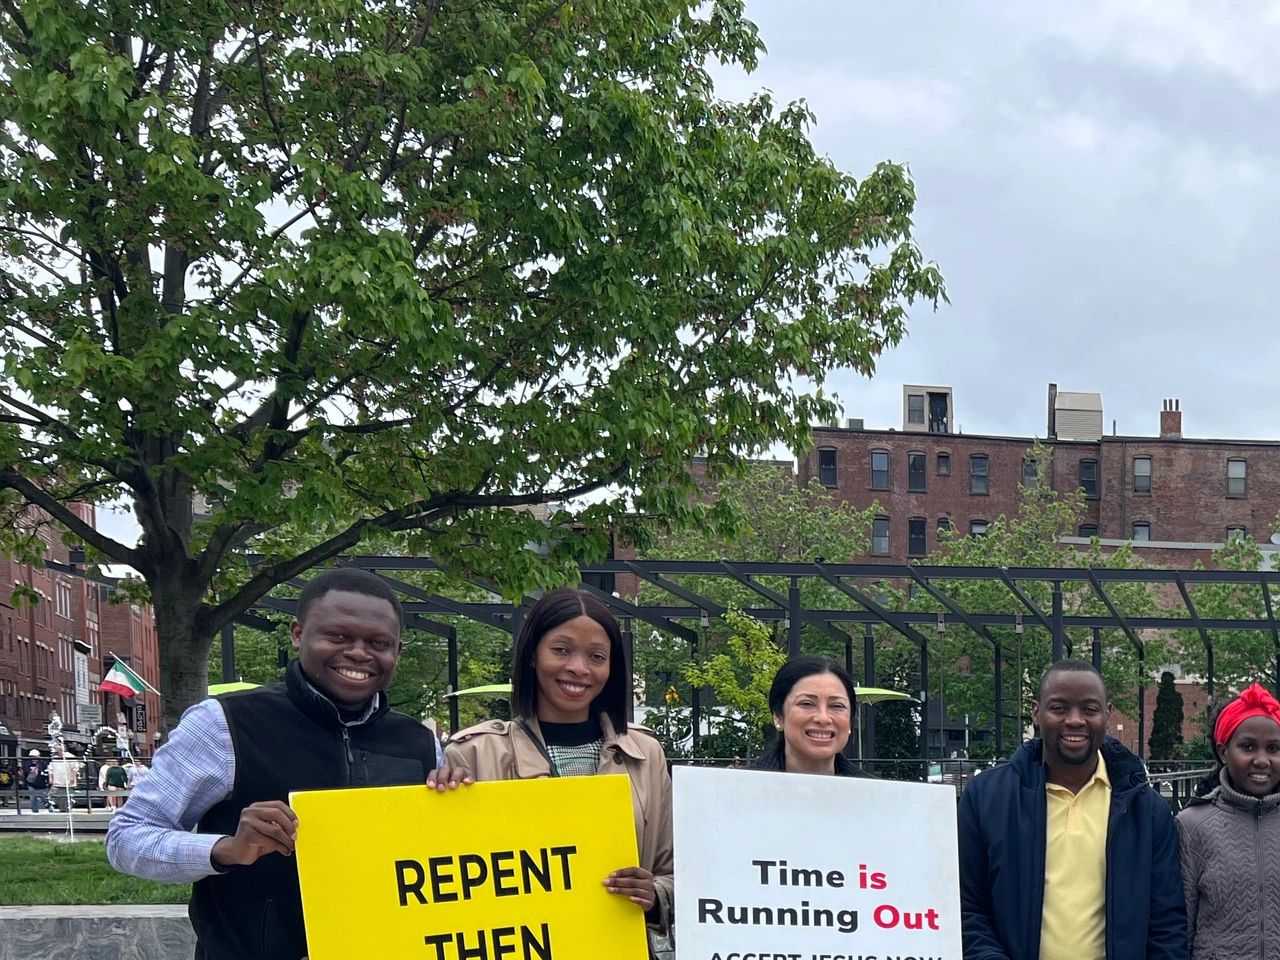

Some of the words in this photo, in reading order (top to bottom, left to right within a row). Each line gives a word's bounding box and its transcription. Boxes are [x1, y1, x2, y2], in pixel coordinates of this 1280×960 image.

[395, 846, 577, 906] REPENT
[752, 860, 845, 888] Time
[858, 865, 887, 890] is
[698, 898, 858, 933] Running
[873, 905, 939, 930] Out
